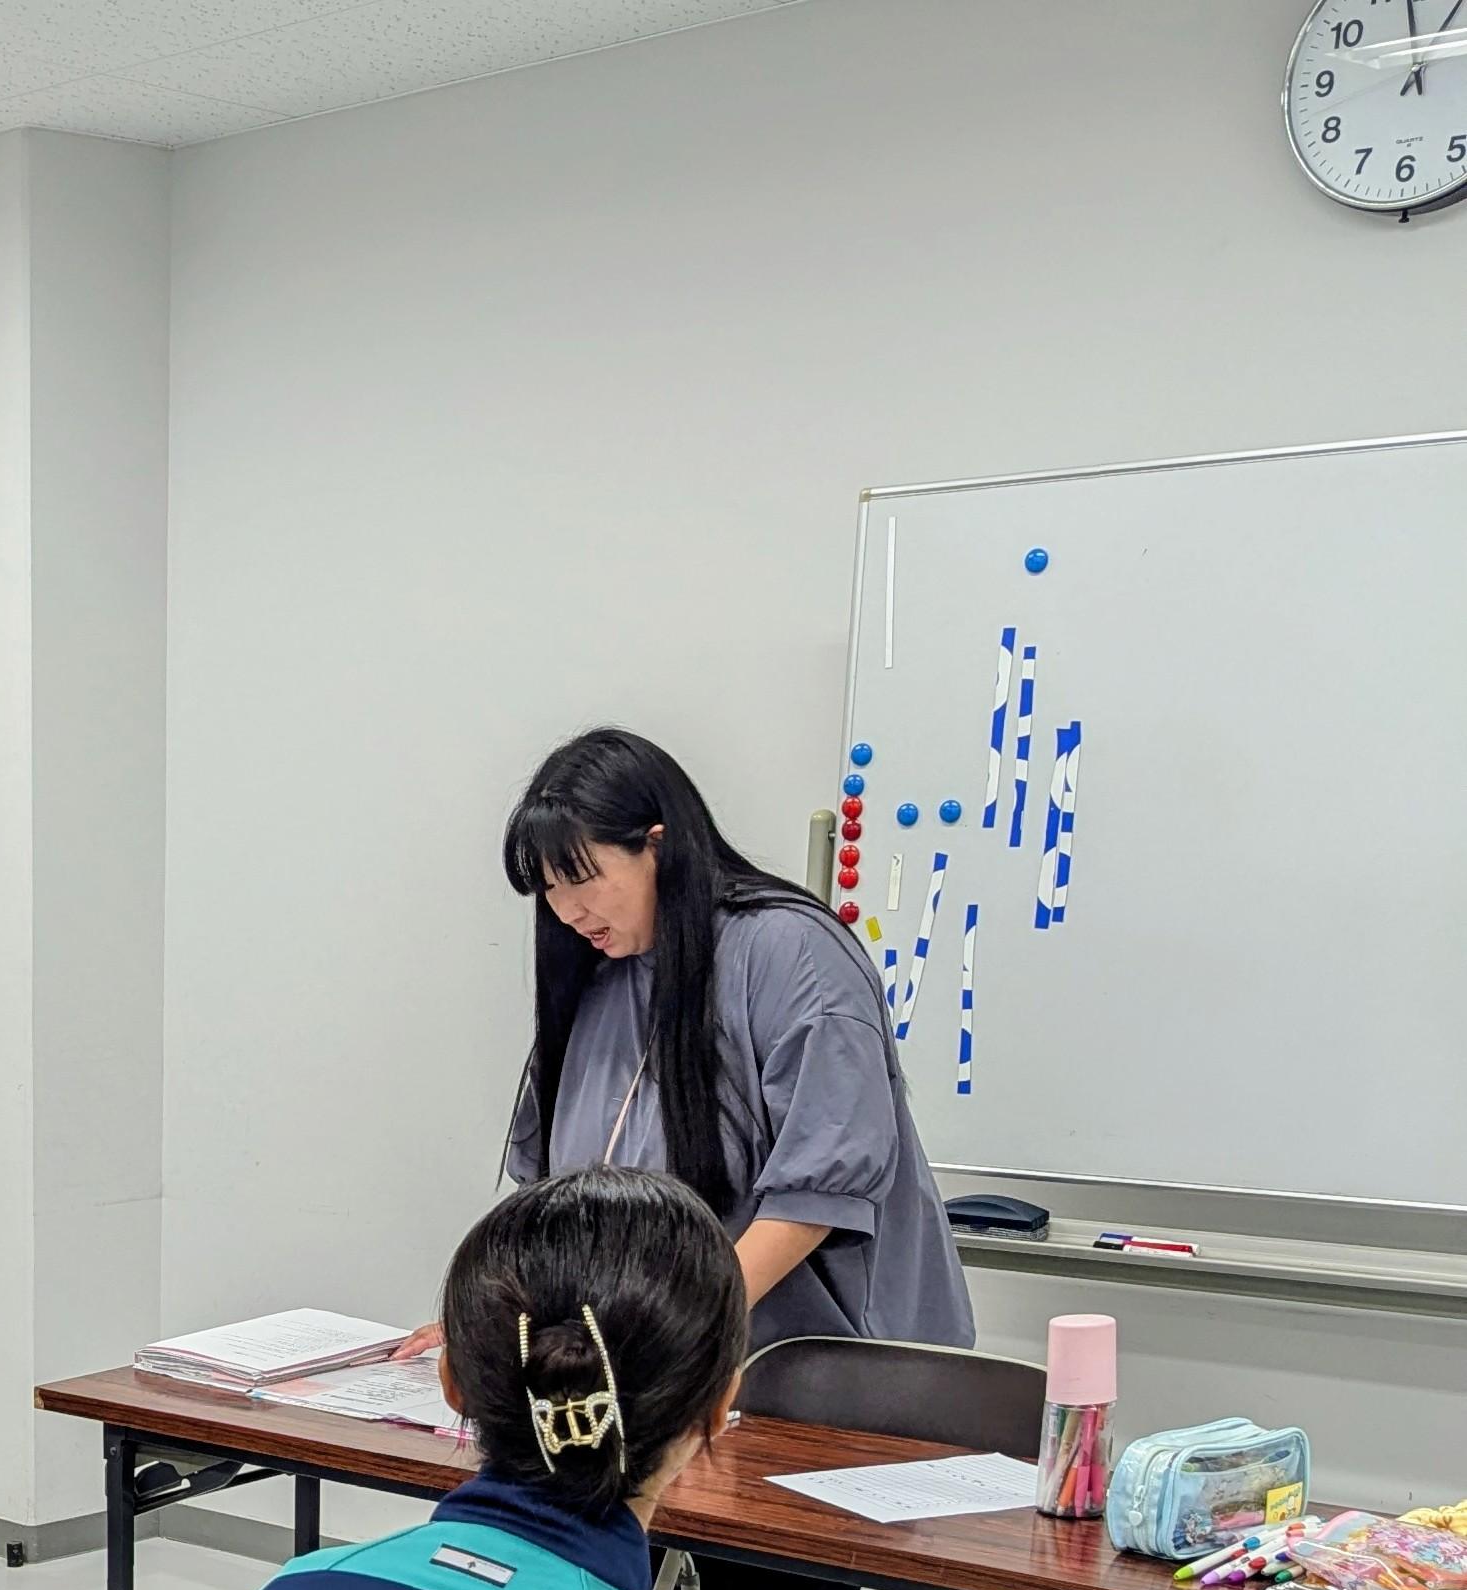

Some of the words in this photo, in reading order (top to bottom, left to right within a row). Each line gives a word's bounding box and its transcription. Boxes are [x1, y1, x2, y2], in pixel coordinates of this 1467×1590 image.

[1331, 19, 1364, 49] 10
[1315, 71, 1334, 97] 9
[1322, 117, 1341, 143] 8
[1355, 148, 1373, 174] 7
[1446, 134, 1467, 163] 5
[1396, 156, 1415, 182] 6
